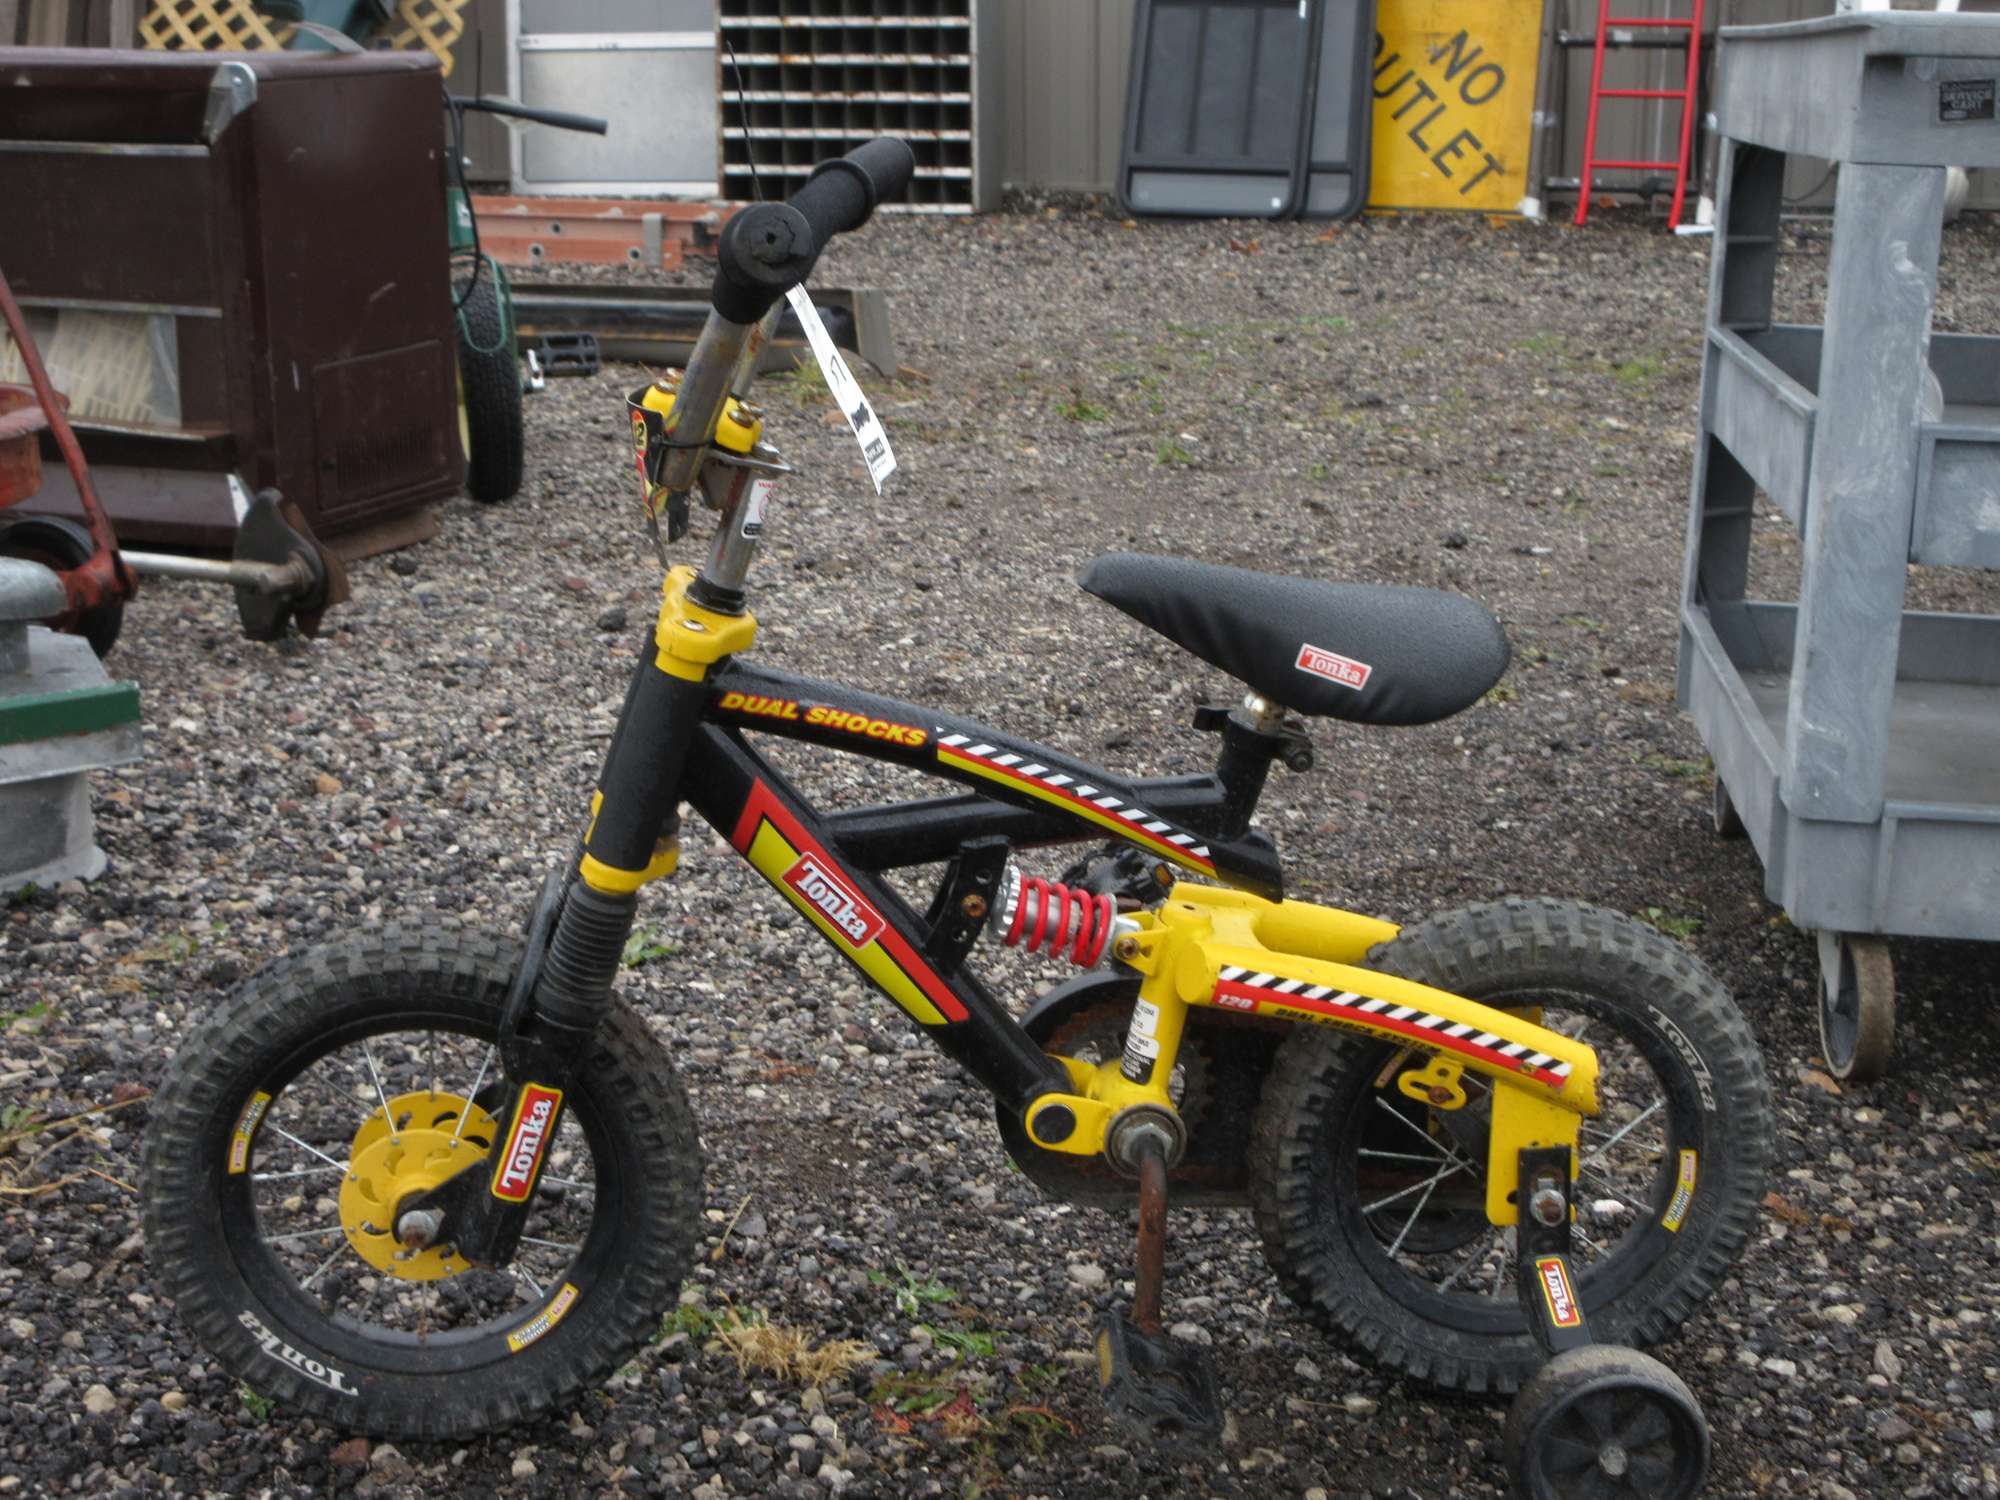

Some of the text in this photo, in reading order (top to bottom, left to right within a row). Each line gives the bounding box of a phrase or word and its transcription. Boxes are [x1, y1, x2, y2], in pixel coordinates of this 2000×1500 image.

[1428, 29, 1506, 106] NO
[1304, 649, 1361, 684] Tonka
[720, 691, 929, 747] DUAL SHOCKS
[795, 861, 868, 941] Tonka
[1274, 1007, 1314, 1022] DUAL
[1319, 1017, 1378, 1035] SHOCK
[1647, 1004, 1717, 1113] Tonka
[501, 1099, 553, 1189] Tonka
[1544, 1264, 1570, 1322] Tonka
[237, 1309, 361, 1397] Tonka
